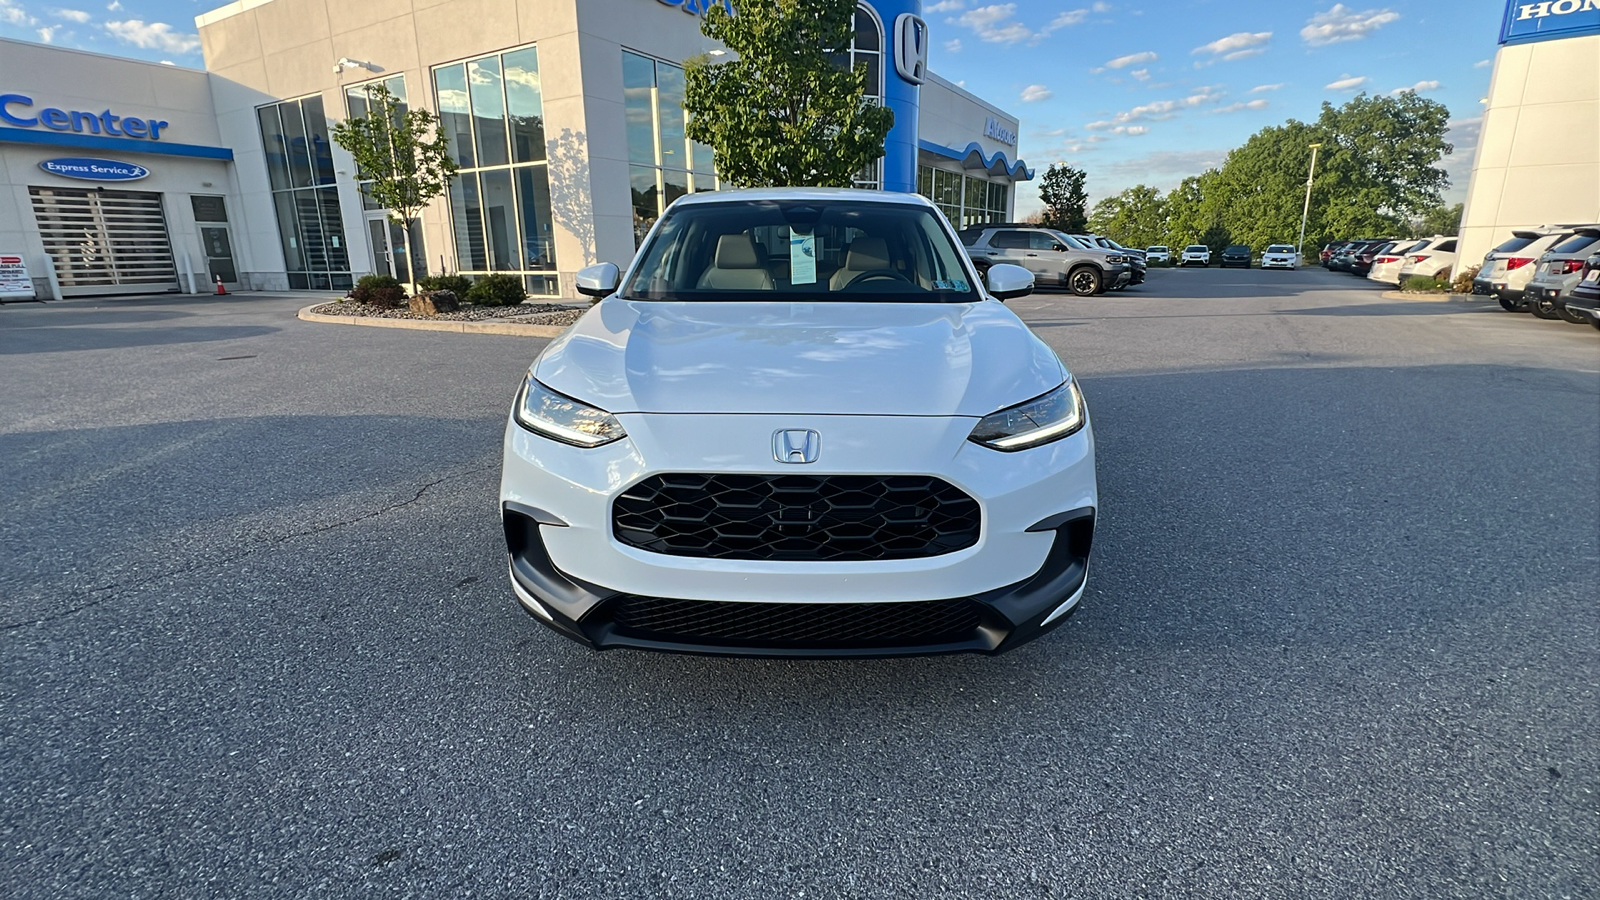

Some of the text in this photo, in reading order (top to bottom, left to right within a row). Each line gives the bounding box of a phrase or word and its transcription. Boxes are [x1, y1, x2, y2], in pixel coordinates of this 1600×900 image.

[0, 93, 169, 140] Center
[47, 161, 129, 175] Express Service
